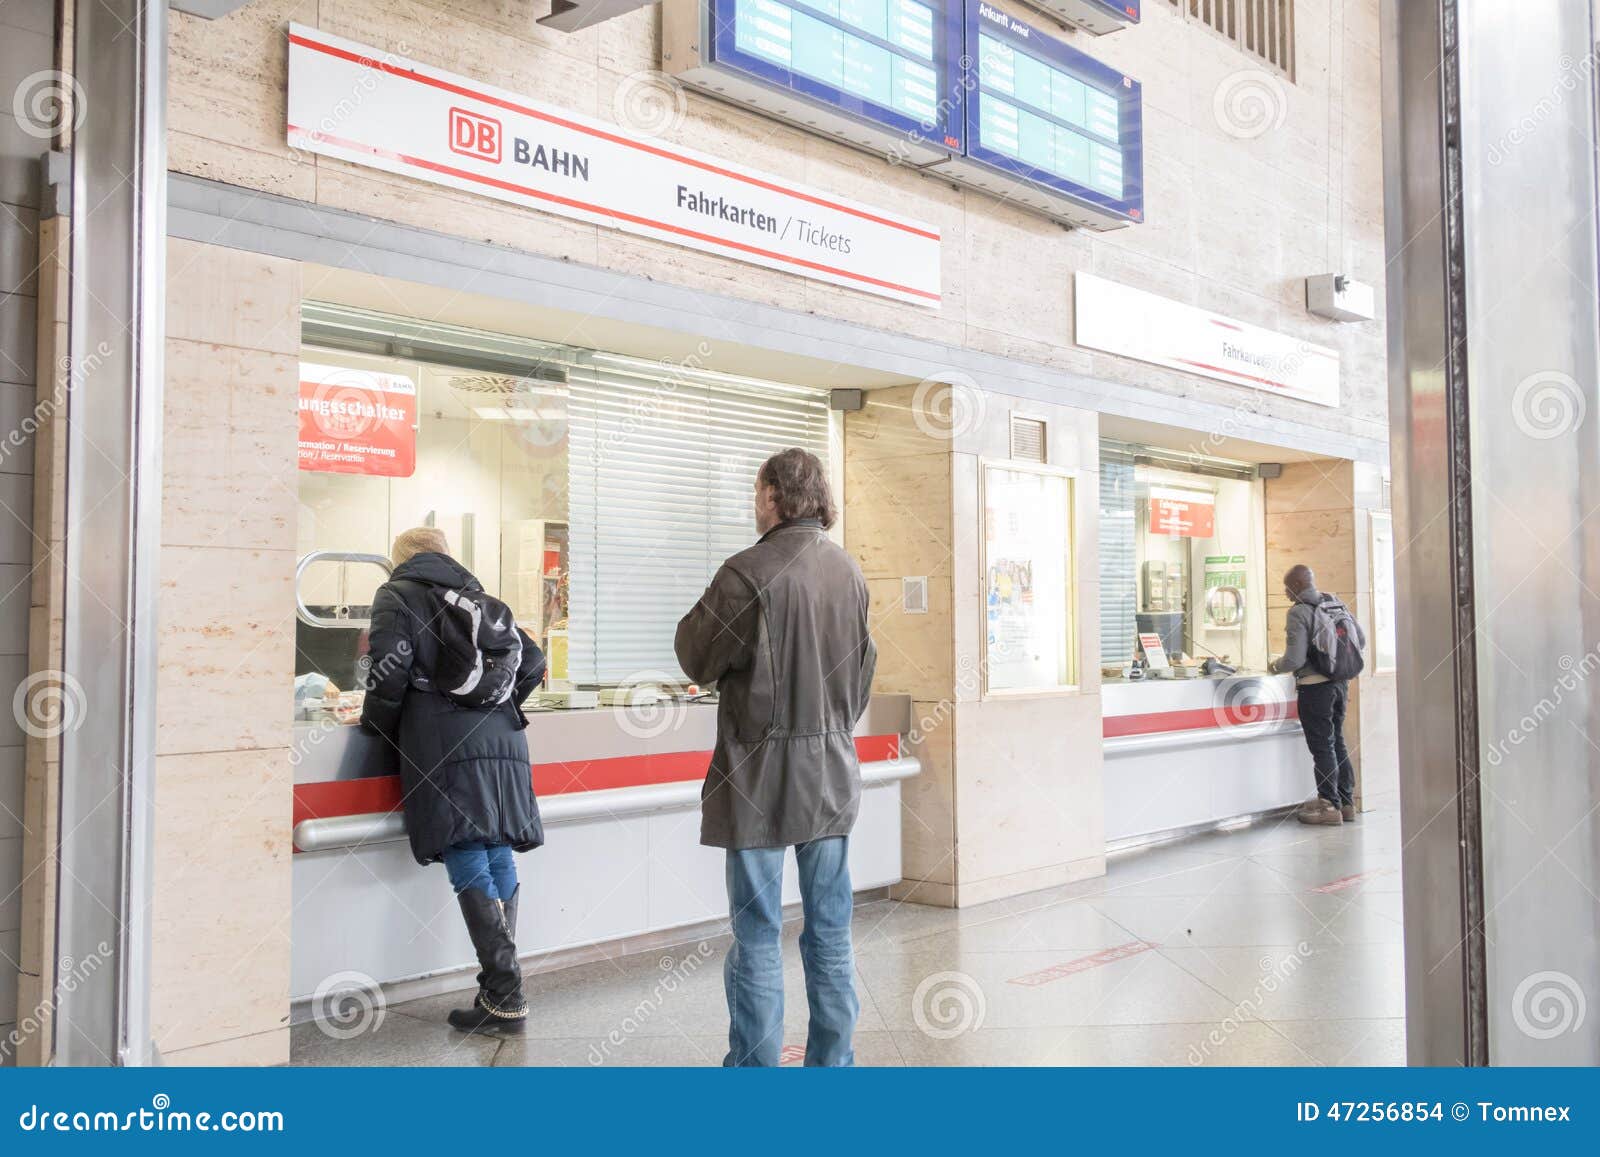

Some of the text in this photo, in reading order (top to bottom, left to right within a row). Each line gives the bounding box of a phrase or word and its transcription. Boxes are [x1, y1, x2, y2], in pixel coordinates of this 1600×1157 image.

[979, 3, 1008, 28] Ankunft
[455, 114, 589, 182] DB BAHN
[677, 185, 852, 254] Fahrkarten / Tickets
[344, 442, 395, 457] Reservierung
